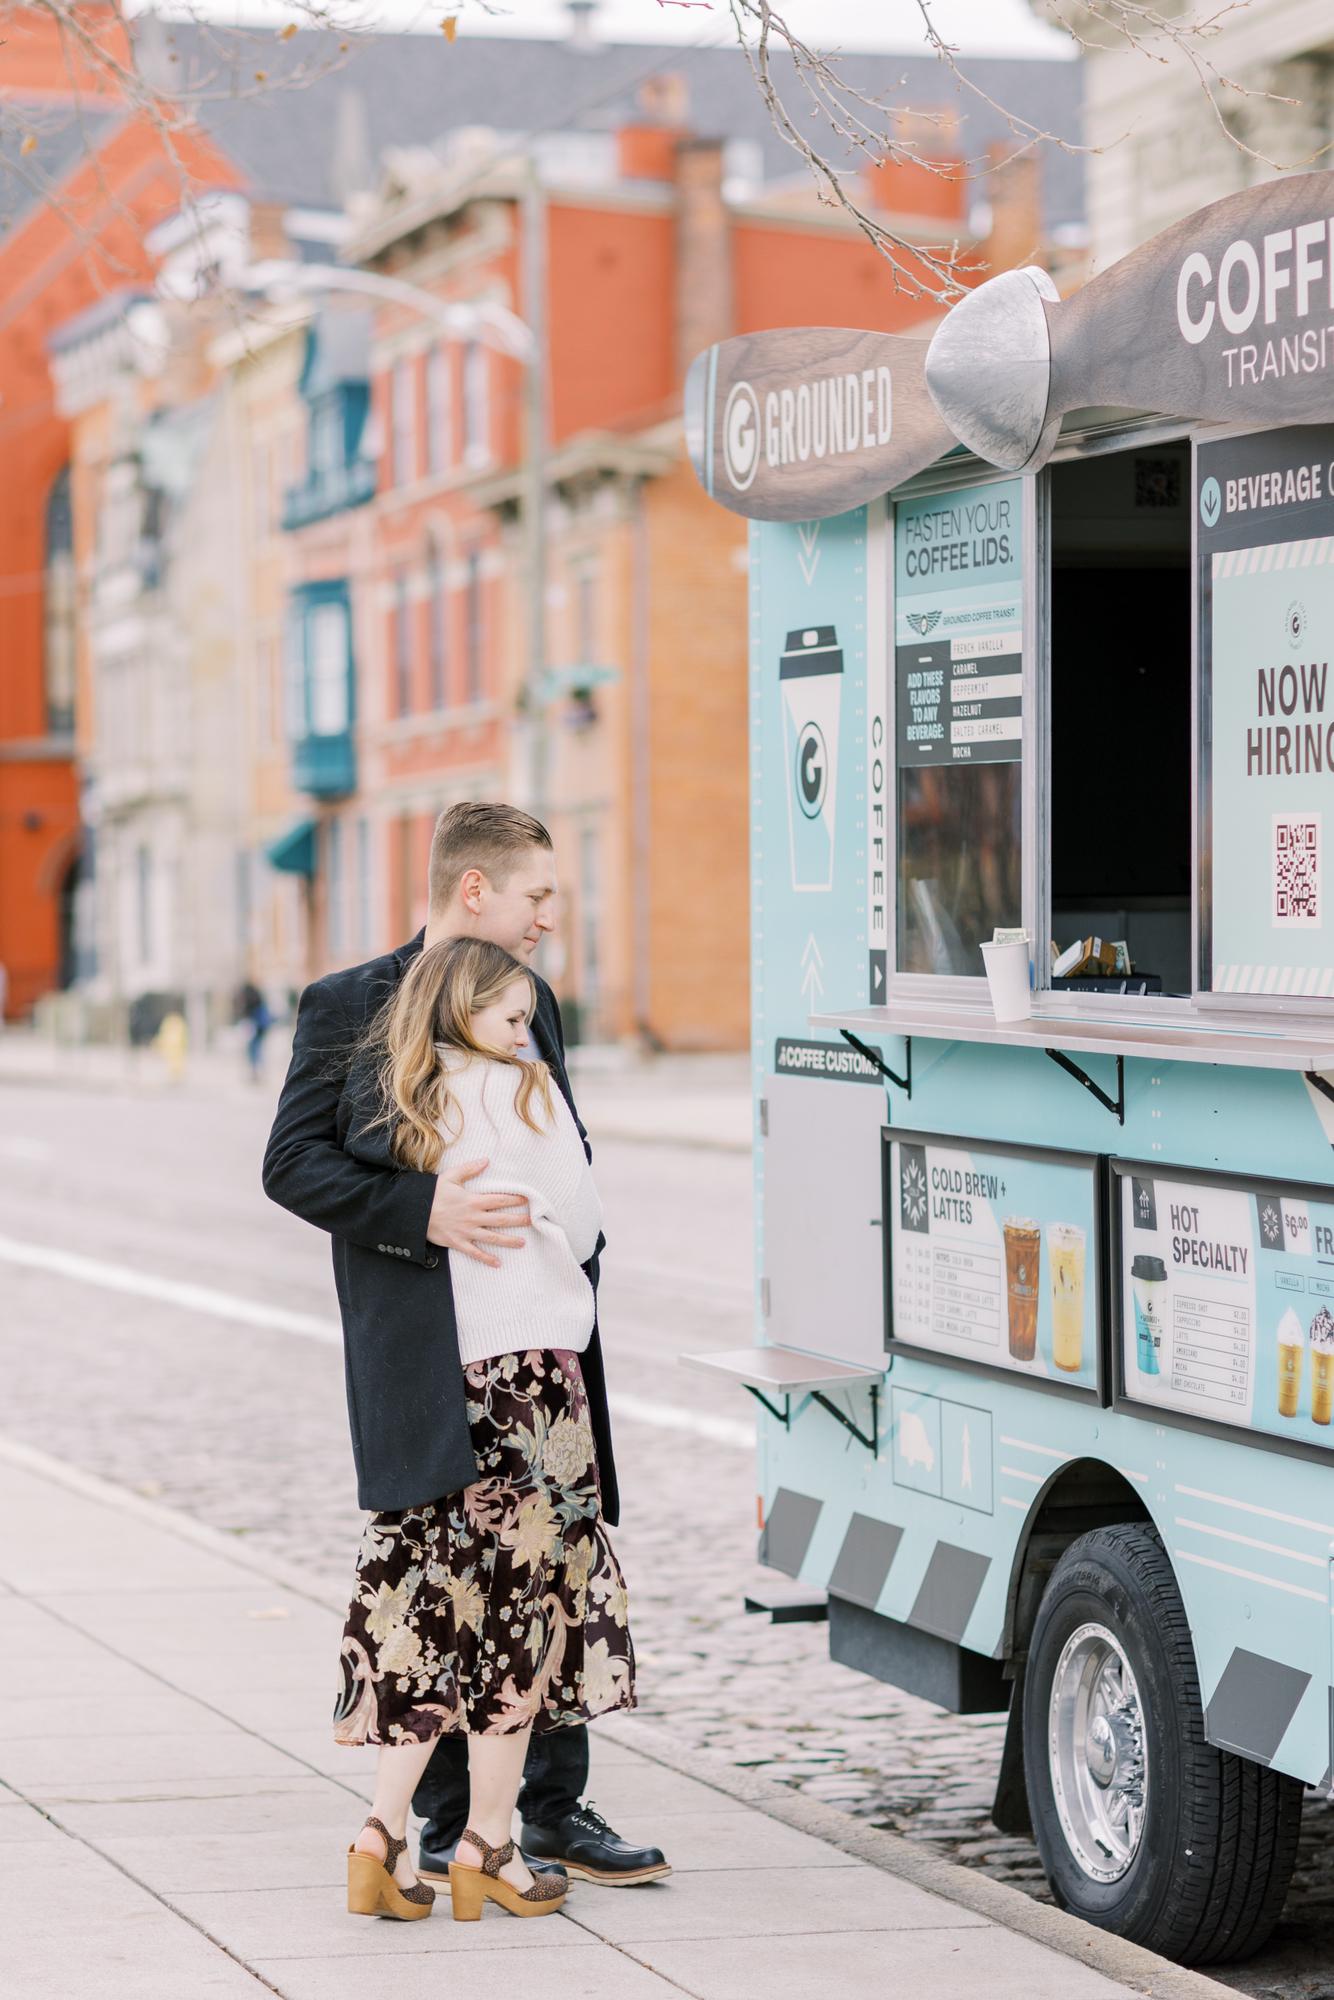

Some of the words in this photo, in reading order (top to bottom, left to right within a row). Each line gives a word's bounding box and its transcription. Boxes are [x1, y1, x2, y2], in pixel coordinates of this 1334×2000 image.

[1177, 216, 1334, 344] COFF
[765, 366, 893, 467] GROUNDED
[1226, 464, 1321, 513] BEVERAGE
[905, 509, 961, 545] FASTEN
[965, 500, 1010, 533] YOUR
[905, 541, 969, 578] COFFEE
[973, 534, 1013, 568] LIDS.
[943, 614, 971, 625] GROUNDED
[972, 610, 992, 622] COFFEE
[993, 607, 1015, 618] TRANSIT
[953, 643, 974, 655] FRENCH
[978, 640, 1004, 652] VANILLA
[907, 672, 922, 689] ADD
[922, 670, 944, 687] THESE
[952, 663, 979, 676] CARAMEL
[910, 689, 941, 706] FLAVORS
[1258, 663, 1328, 717] NOW
[912, 707, 922, 723] TO
[923, 706, 938, 722] ANY
[952, 704, 982, 717] HAZELNUT
[907, 723, 944, 741] BEVERAGE:
[978, 723, 1003, 735] CARAMEL
[952, 746, 971, 758] MOCHA
[872, 715, 883, 930] COFFEE
[786, 1047, 825, 1070] COFFEE
[932, 1167, 962, 1193] COLD
[965, 1172, 997, 1200] BREW
[933, 1196, 972, 1224] LATTES
[1170, 1204, 1199, 1234] HOT
[1285, 1214, 1308, 1238] $6.00
[1172, 1238, 1248, 1275] SPECIALTY
